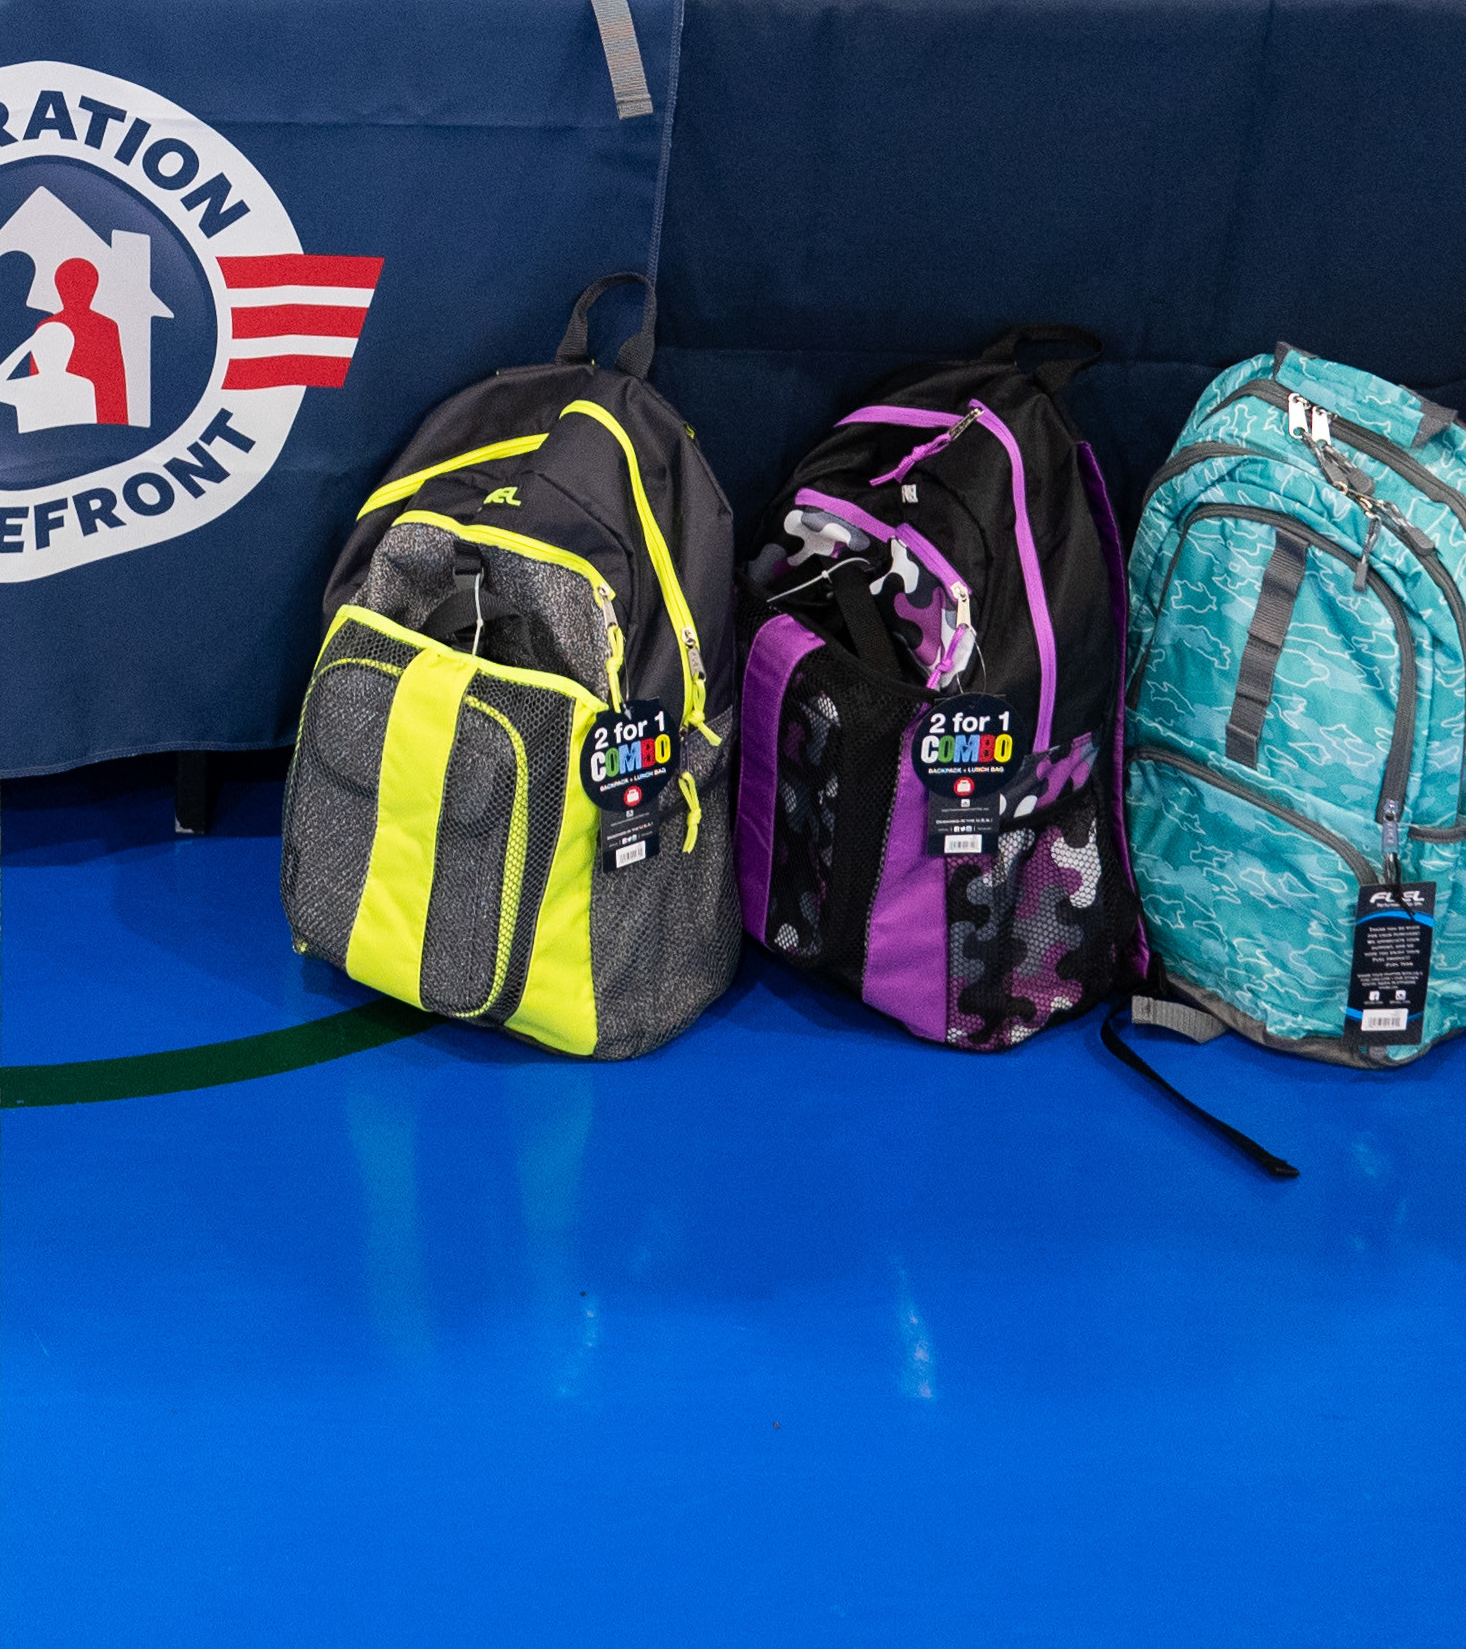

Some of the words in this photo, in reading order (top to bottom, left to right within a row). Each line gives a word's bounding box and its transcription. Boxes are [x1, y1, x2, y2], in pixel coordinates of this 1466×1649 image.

[594, 727, 608, 750] 2
[613, 720, 648, 743] for
[654, 711, 665, 732] 1
[929, 713, 946, 734] 2
[952, 712, 990, 733] for
[998, 711, 1010, 732] 1
[590, 734, 671, 782] COMBO
[920, 733, 1013, 764] COMBO
